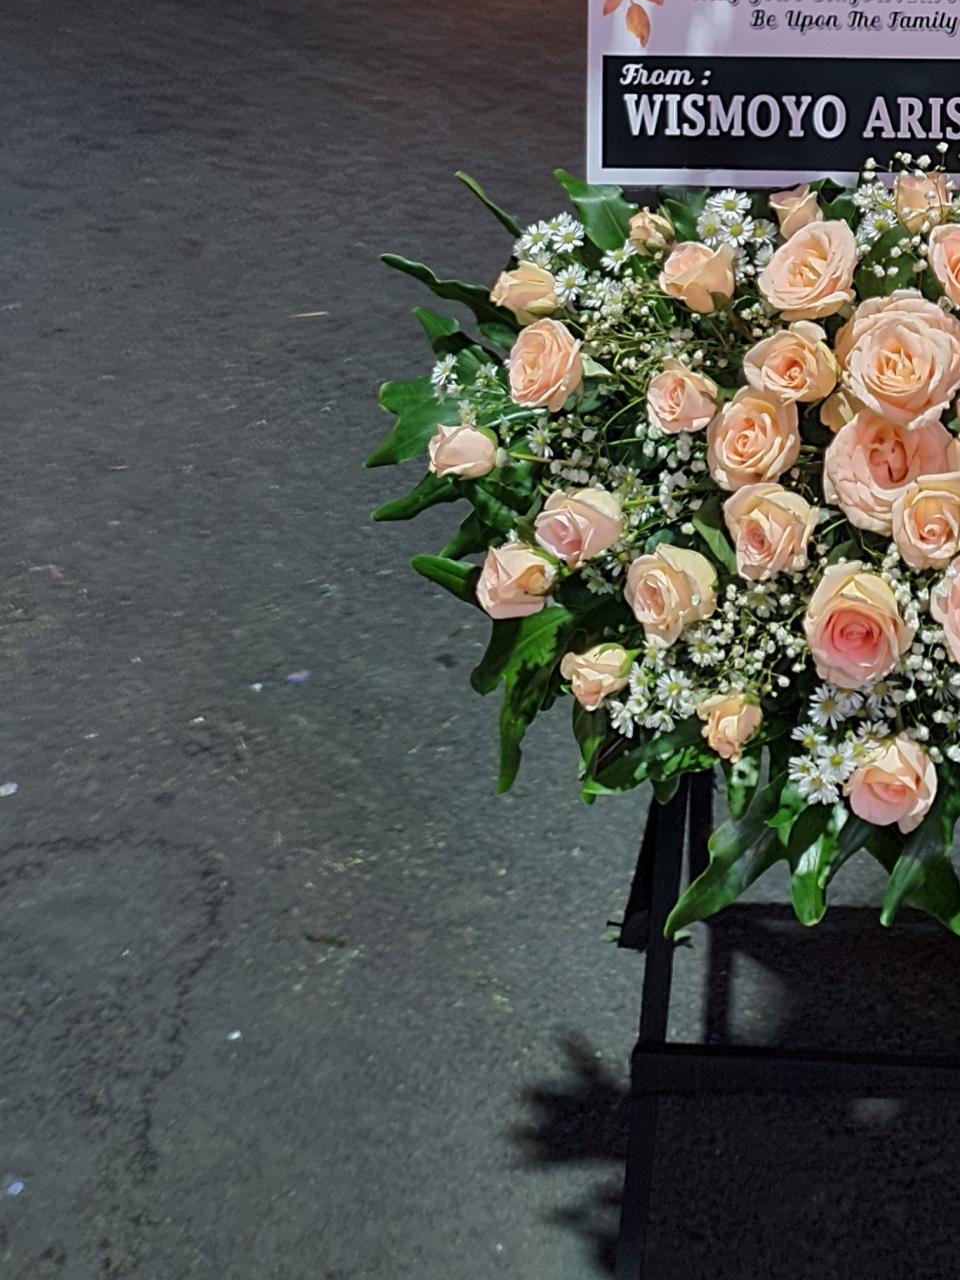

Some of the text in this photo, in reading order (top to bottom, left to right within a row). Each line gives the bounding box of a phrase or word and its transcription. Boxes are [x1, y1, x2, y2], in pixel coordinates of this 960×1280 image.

[751, 10, 958, 34] Be Upon The Family
[623, 93, 847, 138] WISMOYO
